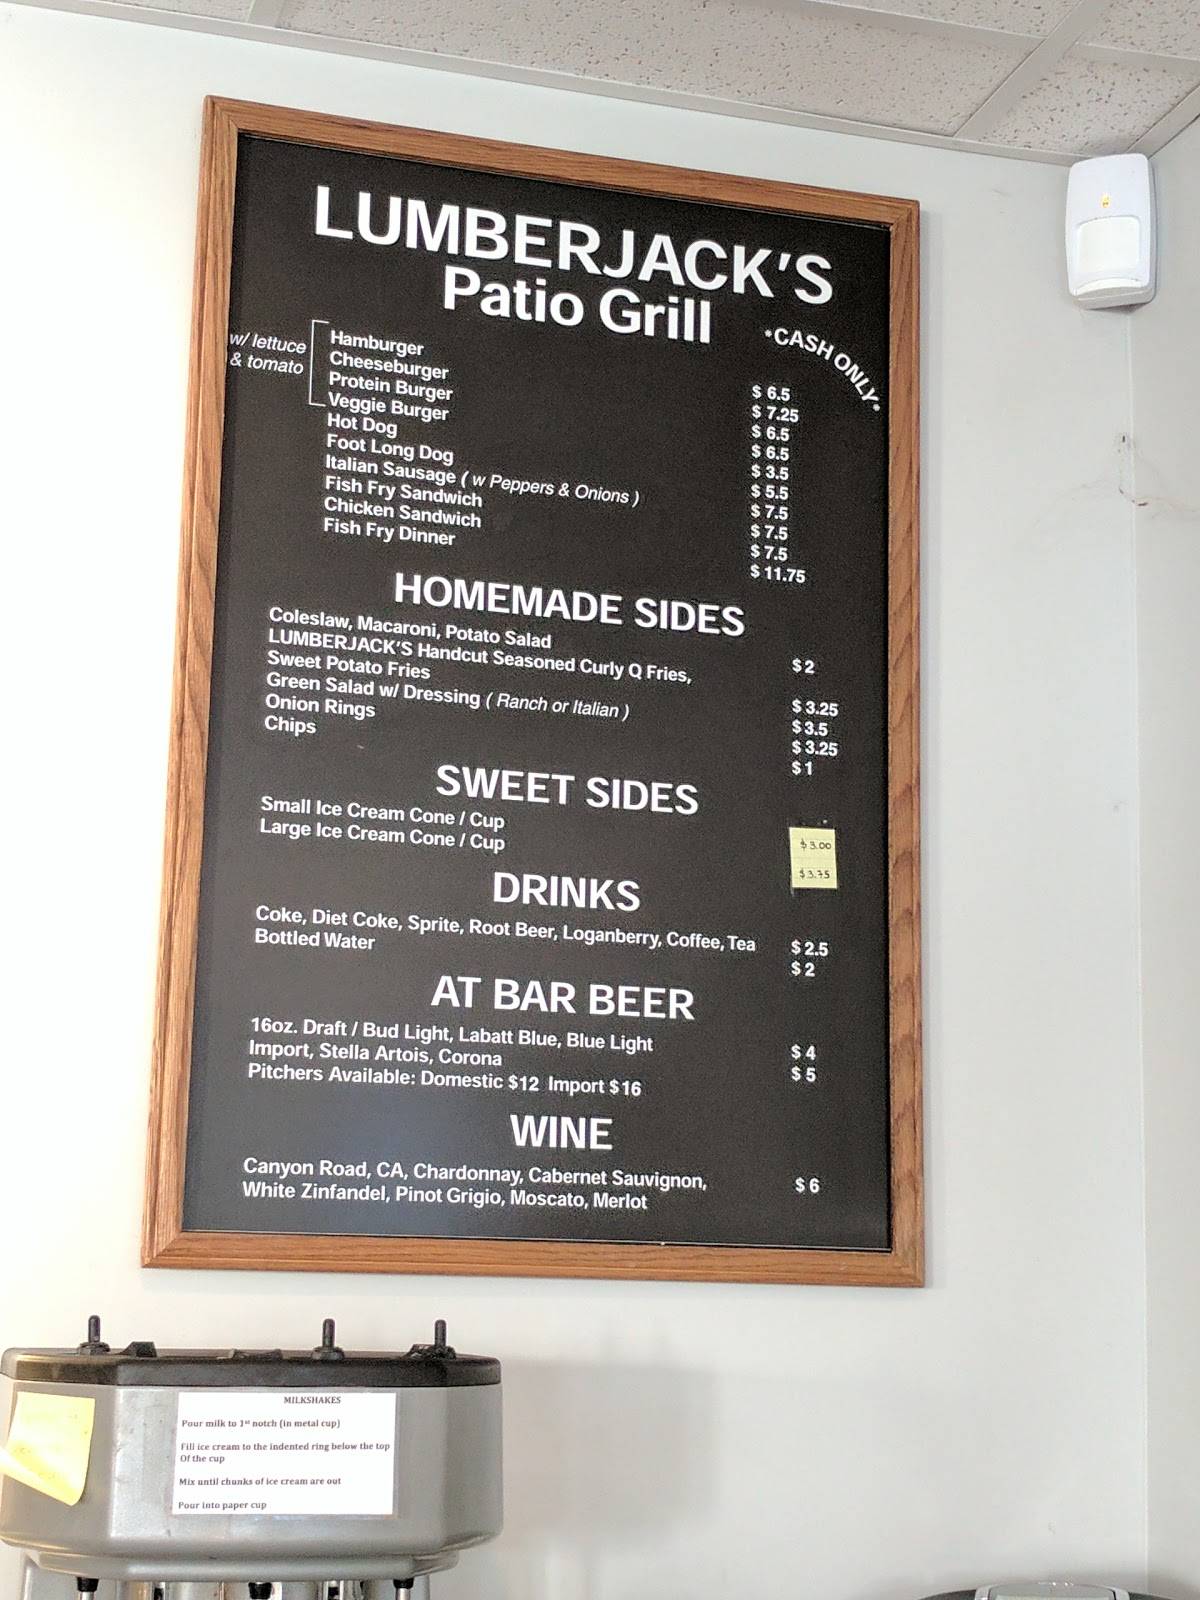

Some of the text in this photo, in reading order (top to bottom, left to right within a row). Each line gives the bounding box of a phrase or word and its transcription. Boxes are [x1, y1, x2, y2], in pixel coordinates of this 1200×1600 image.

[314, 184, 834, 304] LUMBERJACK'S
[444, 264, 712, 344] Patio Grill
[252, 334, 306, 354] lettuce
[331, 330, 424, 358] Hamburger
[247, 354, 304, 374] tomato
[330, 350, 449, 381] Cheeseburger
[329, 371, 453, 402] Protein Burger
[328, 391, 449, 422] Veggie Burger
[327, 412, 397, 439] Hot Dog
[327, 433, 454, 466] Foot Long Dog
[325, 475, 482, 508] Fish Fry Sandwich
[326, 454, 629, 504] Italian Sausage w Peppers Onions
[324, 496, 481, 528] Chicken Sandwich
[324, 517, 456, 546] Fish Fry Dinner
[395, 572, 744, 636] HOMEMADE SIDES
[269, 606, 551, 649] Coleslaw, Macaroni, Potato Salad
[267, 650, 430, 679] Sweet Potato Fries
[268, 628, 692, 684] LUMBERJACK'S Handcut Seasoned Curly Q Fries,
[265, 693, 376, 720] Onion Rings
[266, 671, 320, 691] Green
[325, 677, 374, 696] Salad
[404, 684, 480, 710] Dressing
[496, 693, 548, 711] Ranch
[552, 701, 570, 712] or
[572, 700, 619, 718] Italian
[264, 715, 316, 737] Chips
[436, 764, 698, 815] SWEET SIDES
[261, 796, 505, 832] Small Ice Cream Cone Cup
[493, 872, 640, 912] DRINKS
[255, 928, 376, 950] Bottled Water
[256, 905, 756, 951] Coke, Diet Coke, Sprite, Root Beer, Loganberry, Coffee, Tea
[430, 975, 694, 1020] AT BAR BEER
[251, 1017, 653, 1055] 16oz. Draft Bud Light, Labatt Blue, Blue Light
[249, 1039, 502, 1066] Import, Stella Artois, Corona
[248, 1062, 641, 1096] Pitchers Available: Domestic $12 Import $16
[510, 1114, 612, 1150] WINE
[243, 1157, 707, 1192] Canyon Road, CA, Chardonnay, Cabernet Sauvignon,
[242, 1181, 648, 1210] White Zinfandel, Pinot Grigio, Moscato, Merlot
[284, 1396, 341, 1404] MILKSHAKES
[206, 1419, 226, 1427] milk
[279, 1419, 292, 1429] (in
[294, 1419, 319, 1427] metal
[321, 1420, 340, 1429] cup)
[180, 1454, 190, 1462] Of
[209, 1456, 225, 1464] cup
[181, 1443, 195, 1451] Fill
[270, 1442, 309, 1450] indented
[312, 1443, 330, 1452] ring
[331, 1442, 357, 1450] below
[360, 1442, 374, 1450] the
[376, 1443, 390, 1452] top
[179, 1478, 195, 1486] Mix
[198, 1478, 219, 1486] until
[221, 1478, 253, 1486] chunks
[222, 1502, 248, 1511] paper
[250, 1502, 267, 1510] cup
